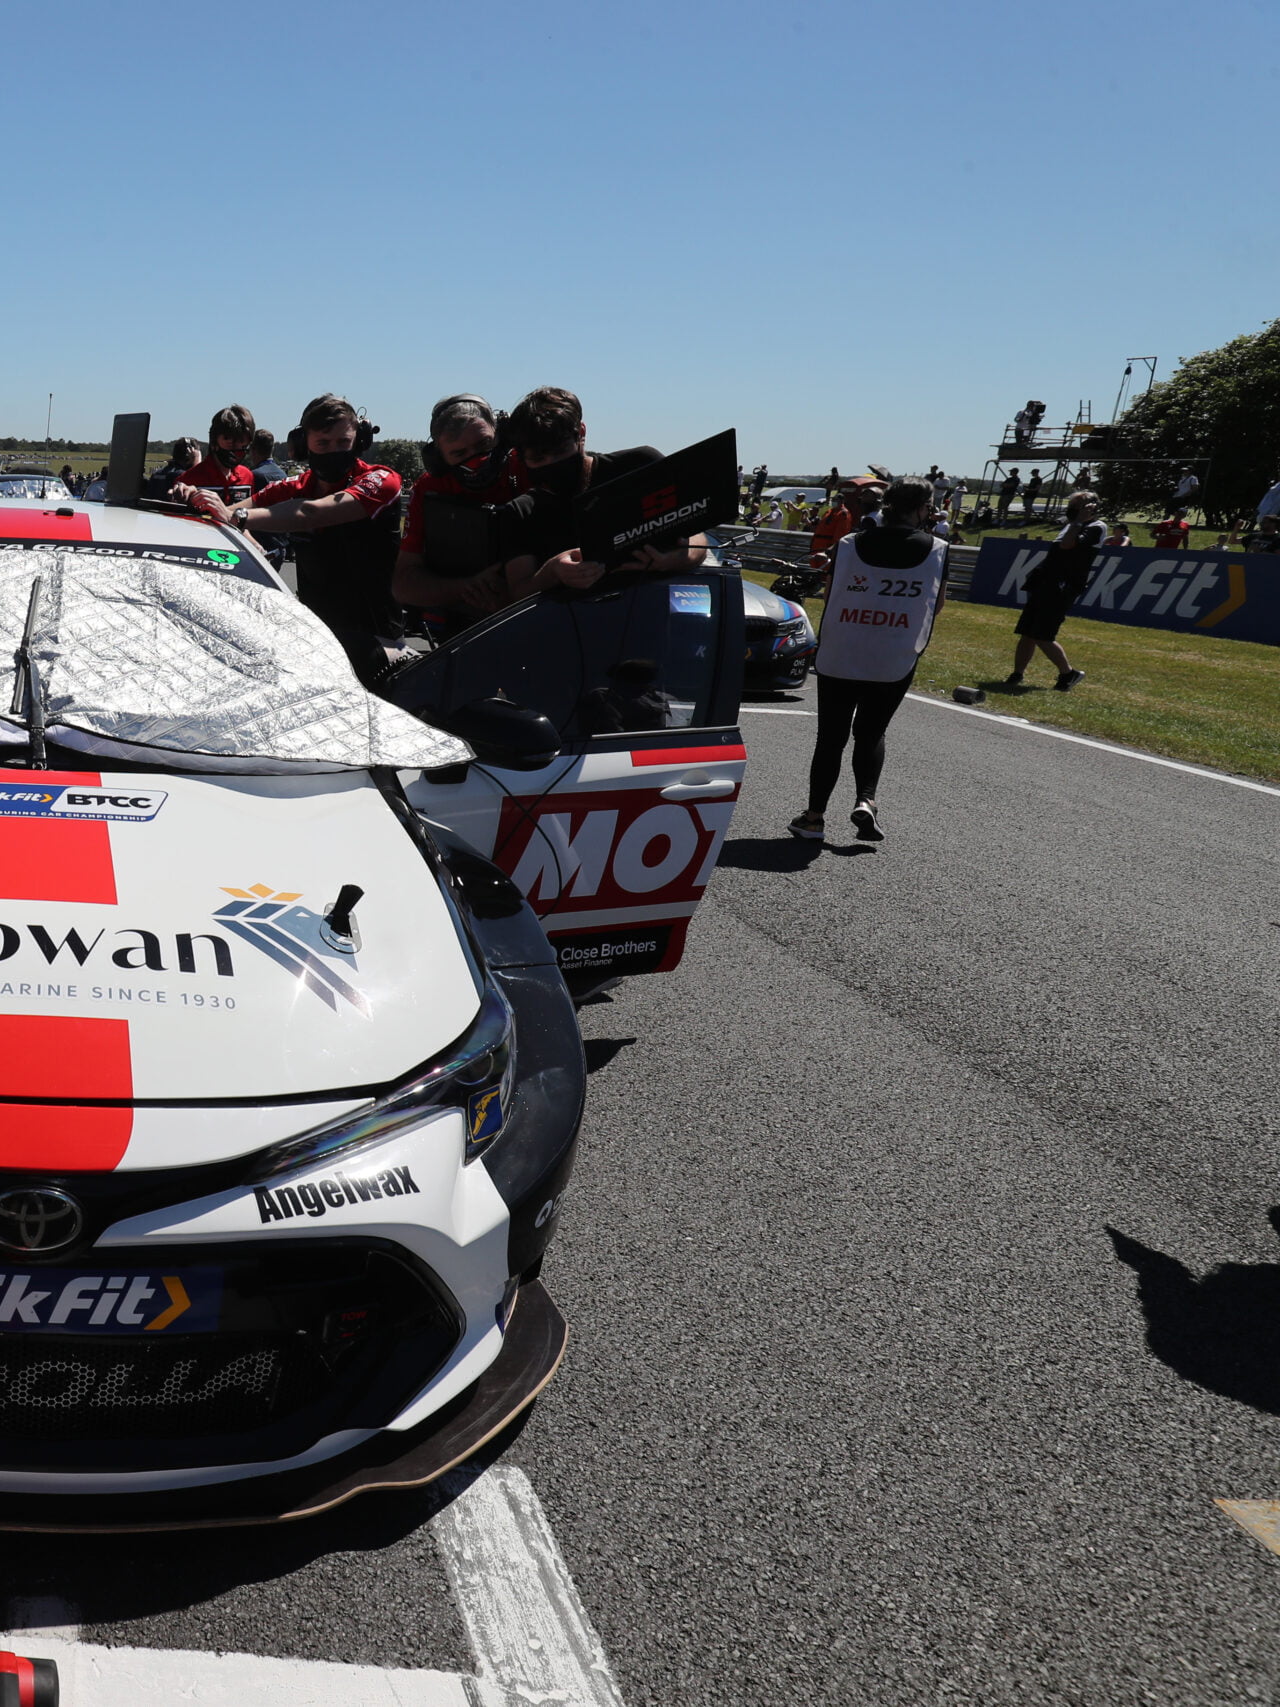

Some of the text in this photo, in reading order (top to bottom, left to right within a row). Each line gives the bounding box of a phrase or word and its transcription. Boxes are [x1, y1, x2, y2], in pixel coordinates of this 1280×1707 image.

[613, 498, 708, 545] SWINDON
[32, 544, 135, 557] GAZOO
[141, 551, 235, 570] Racing
[846, 579, 924, 598] MSV 225
[839, 608, 909, 629] MEDIA
[66, 793, 152, 809] BTCC
[65, 813, 147, 821] CHAMPIONSHIP
[560, 940, 657, 961] Close Brothers
[560, 958, 613, 970] Asset Finance
[91, 986, 167, 1004] SINCE
[180, 992, 237, 1011] 1930
[253, 1163, 420, 1224] Angelwax
